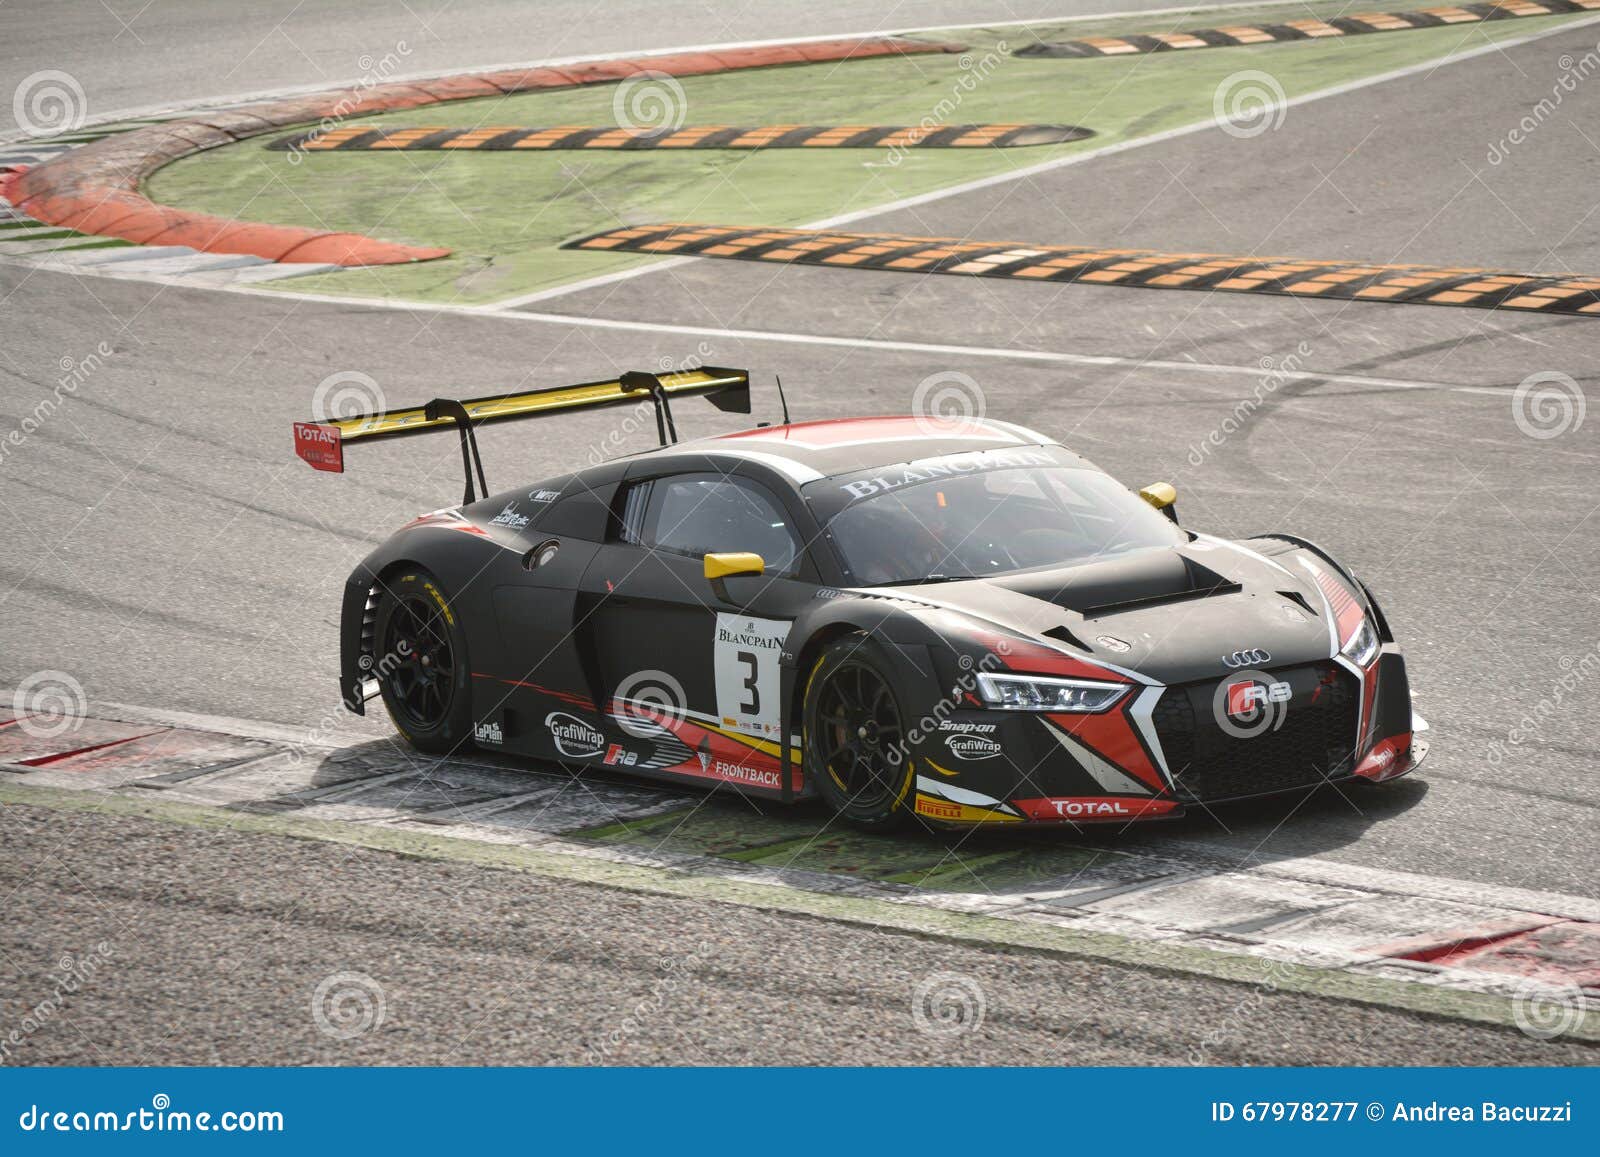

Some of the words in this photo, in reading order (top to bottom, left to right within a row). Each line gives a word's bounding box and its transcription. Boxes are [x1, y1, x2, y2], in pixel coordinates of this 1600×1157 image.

[295, 425, 336, 444] TOTAL
[719, 628, 784, 649] BLANCPAIN
[737, 651, 760, 716] 3
[1238, 682, 1293, 711] R8
[551, 721, 605, 749] GrafiWrap
[938, 720, 996, 733] Snap-on
[950, 740, 1001, 752] GrafiWrap
[609, 747, 638, 766] R8
[715, 761, 780, 786] FRONTBACK
[1051, 800, 1129, 815] TOTAL
